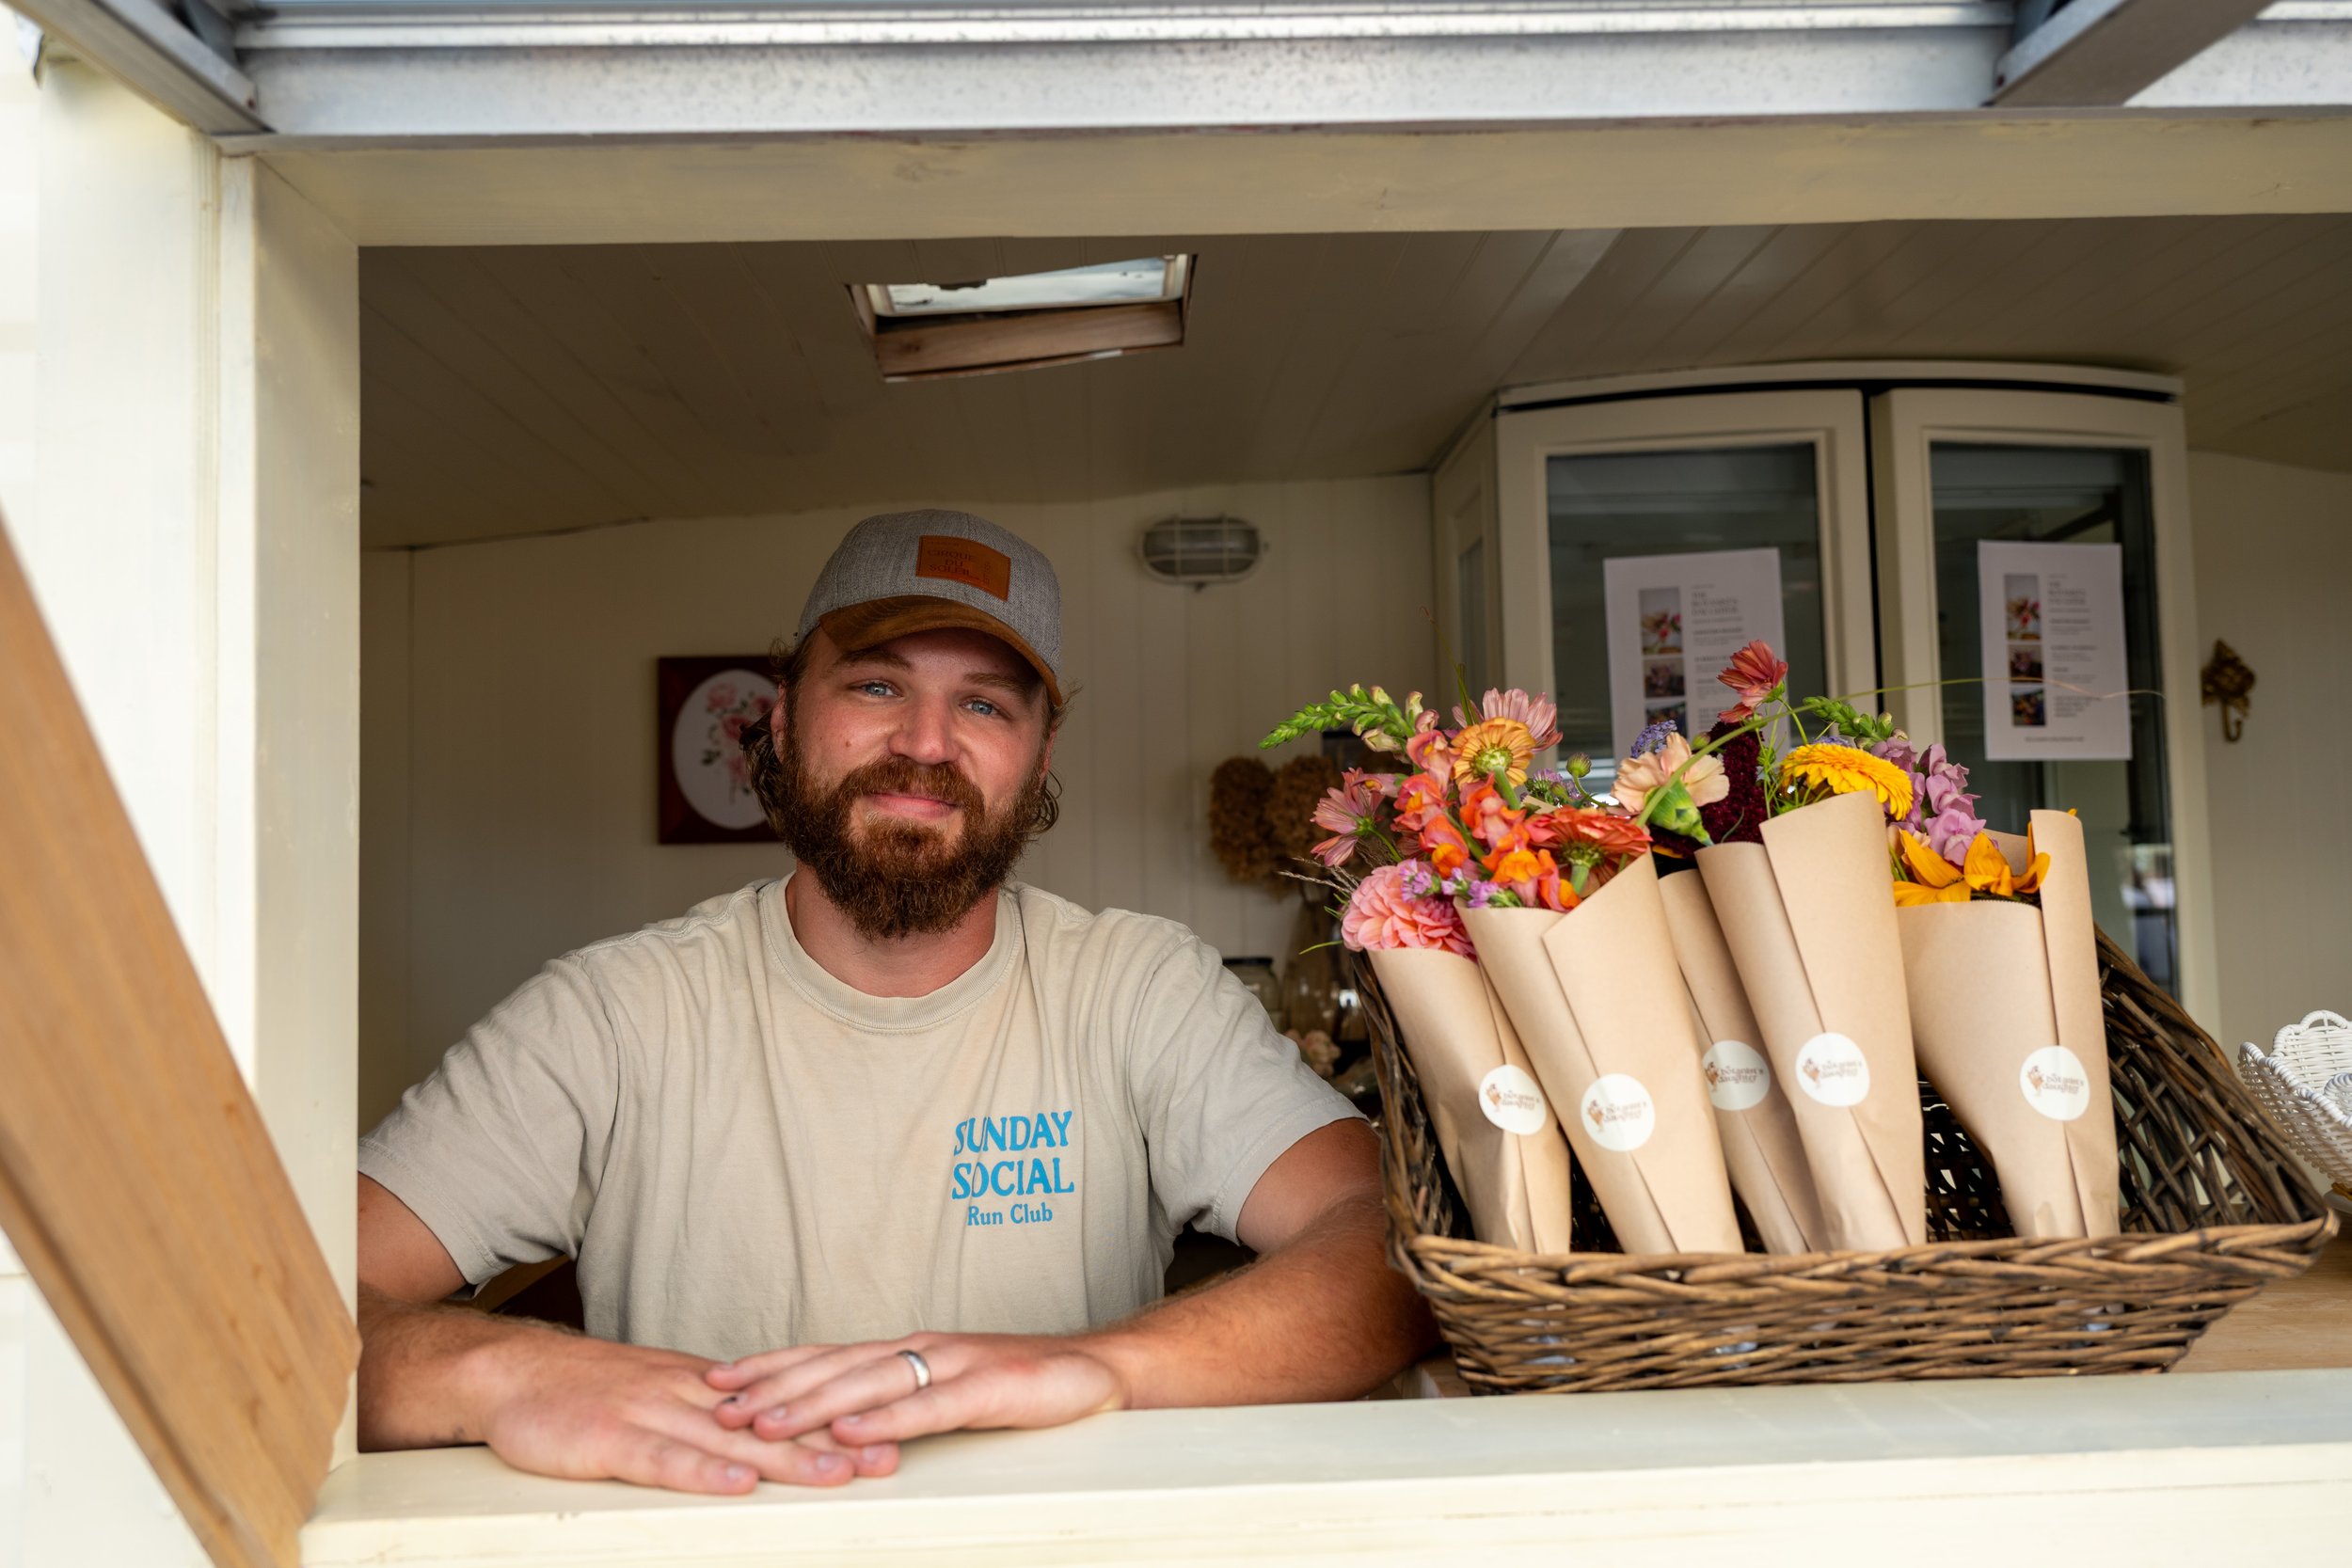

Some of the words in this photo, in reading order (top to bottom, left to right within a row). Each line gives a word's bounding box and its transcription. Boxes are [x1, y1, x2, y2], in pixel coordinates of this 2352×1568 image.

[927, 549, 975, 562] CIRQUE
[945, 559, 963, 567] DU
[928, 563, 970, 577] SOLEIL
[953, 1110, 1073, 1156] SUNDAY
[951, 1157, 1074, 1199] SOCIAL
[967, 1205, 1004, 1226] Run
[1009, 1201, 1053, 1224] Club
